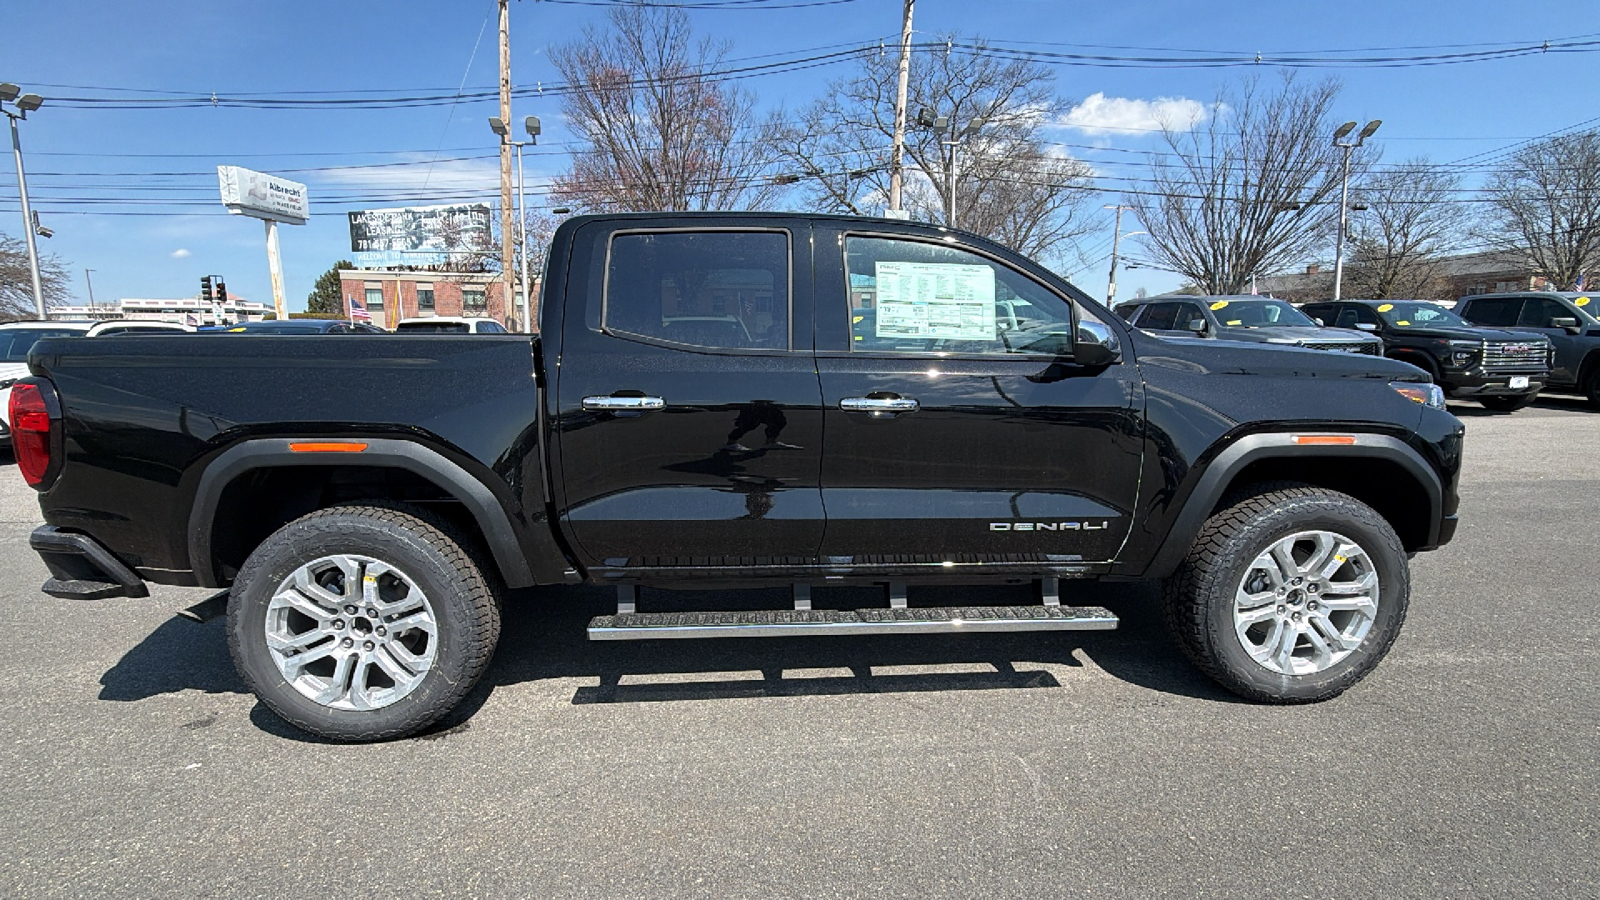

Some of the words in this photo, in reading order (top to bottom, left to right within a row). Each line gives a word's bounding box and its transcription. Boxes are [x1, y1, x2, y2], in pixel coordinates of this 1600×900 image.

[269, 182, 301, 198] Albrecht
[351, 213, 391, 224] LAKESIDE
[391, 212, 414, 223] PARK
[366, 225, 402, 236] LEASING
[357, 252, 388, 261] WELCOME
[391, 251, 401, 260] TO
[989, 520, 1108, 532] DENALI
